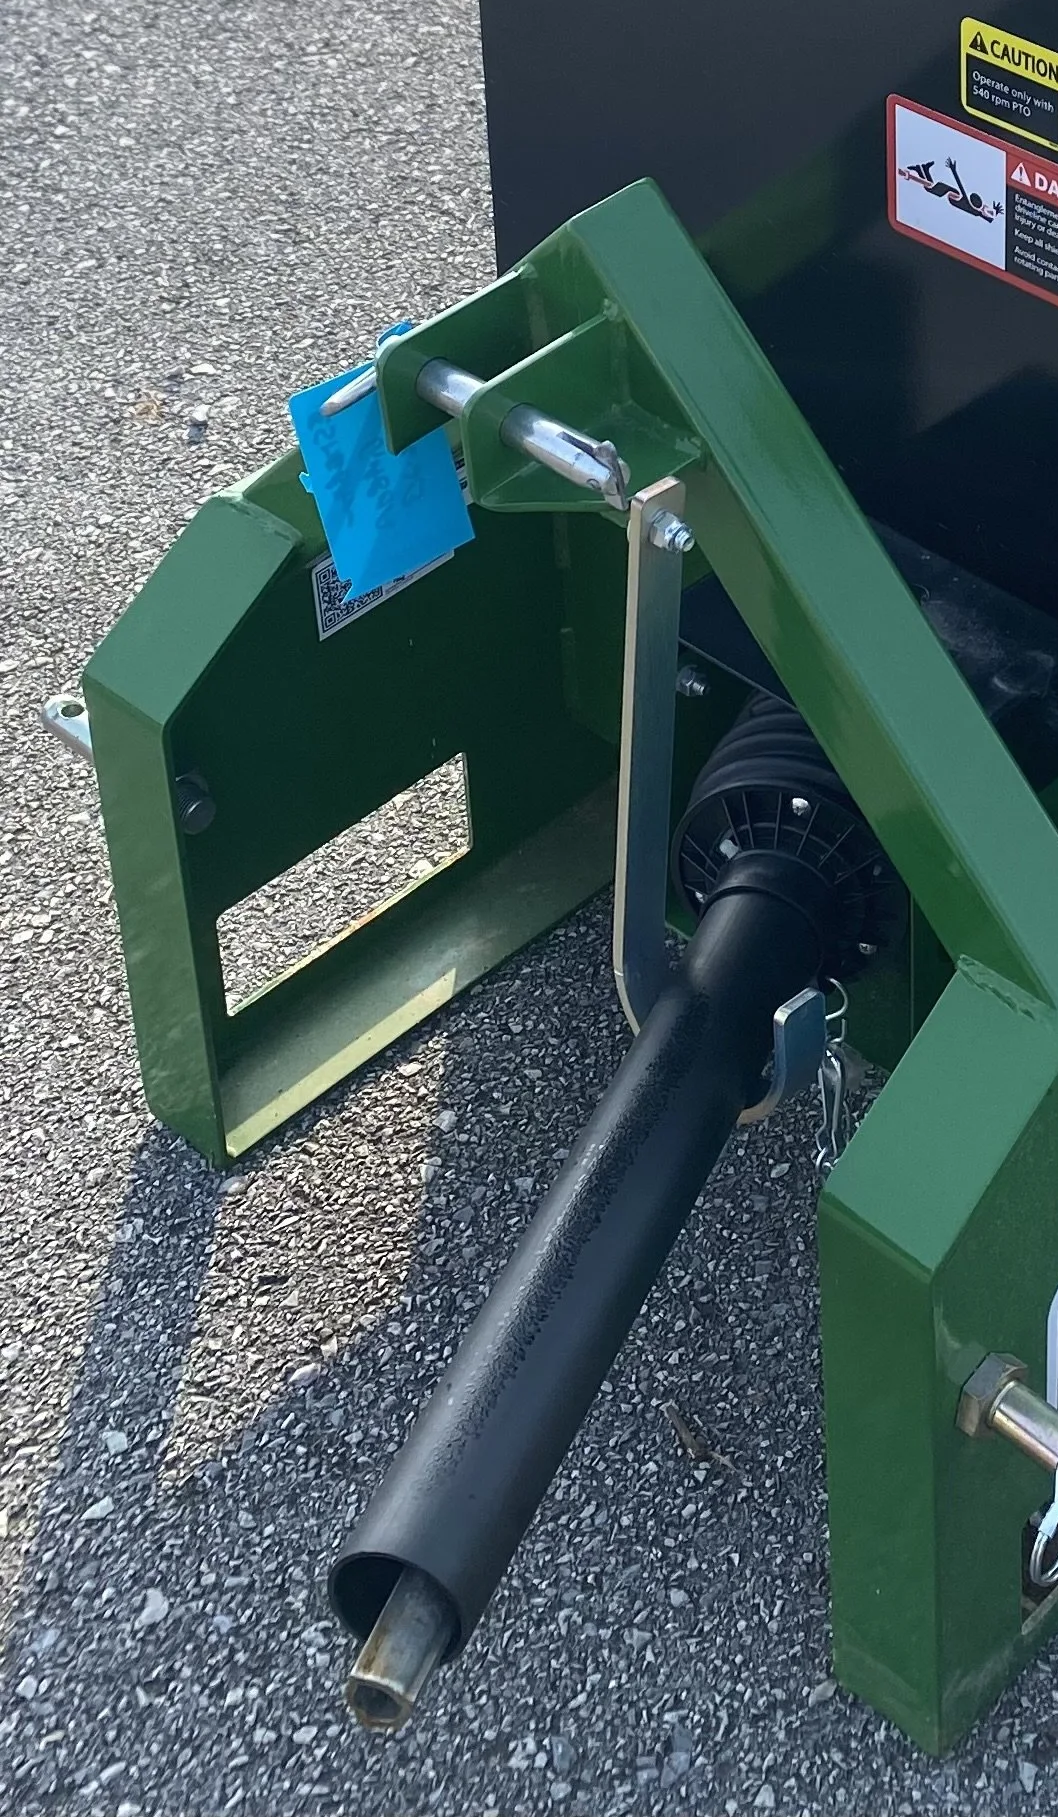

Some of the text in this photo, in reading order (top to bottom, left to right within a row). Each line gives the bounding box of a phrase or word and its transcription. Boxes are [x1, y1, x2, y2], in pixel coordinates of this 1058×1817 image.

[990, 39, 1058, 84] CAUTION
[972, 70, 1054, 113] Operate only with
[972, 85, 1031, 117] 540 rpm PTO
[1014, 203, 1046, 224] driveline
[1014, 212, 1036, 231] injury
[1036, 223, 1045, 233] or
[1014, 227, 1033, 246] Keep
[1034, 236, 1043, 248] all
[1014, 244, 1035, 261] Avoid
[1013, 255, 1043, 277] rotating
